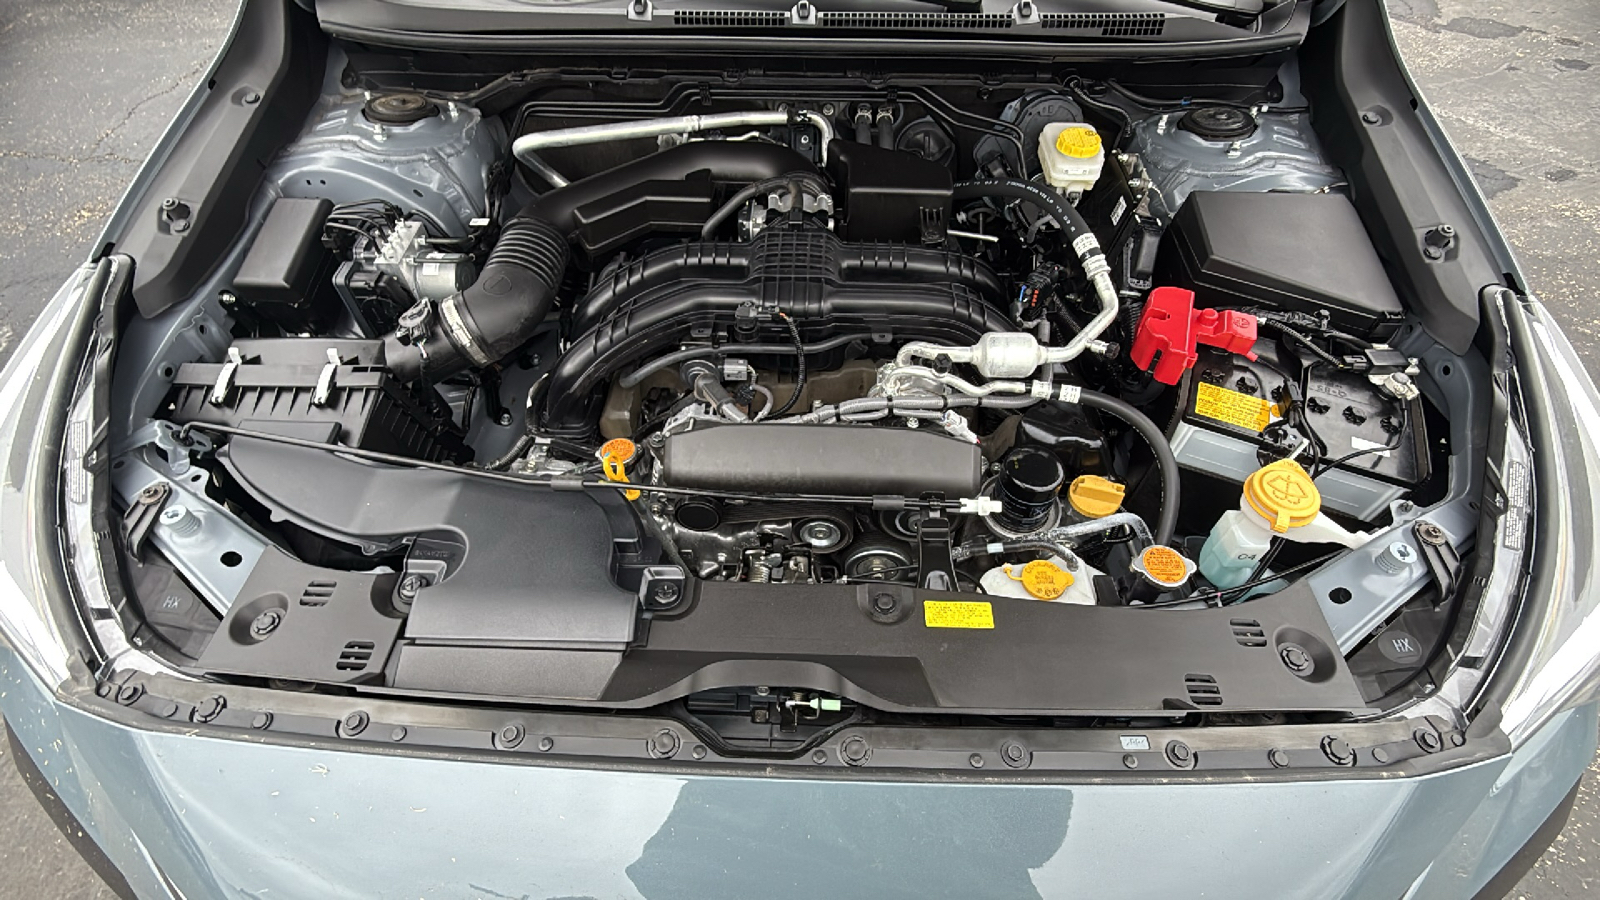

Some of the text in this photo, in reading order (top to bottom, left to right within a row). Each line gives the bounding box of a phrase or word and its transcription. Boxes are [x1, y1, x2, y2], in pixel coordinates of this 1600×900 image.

[1238, 553, 1257, 561] C4
[162, 595, 182, 609] HX
[1391, 637, 1414, 653] HX
